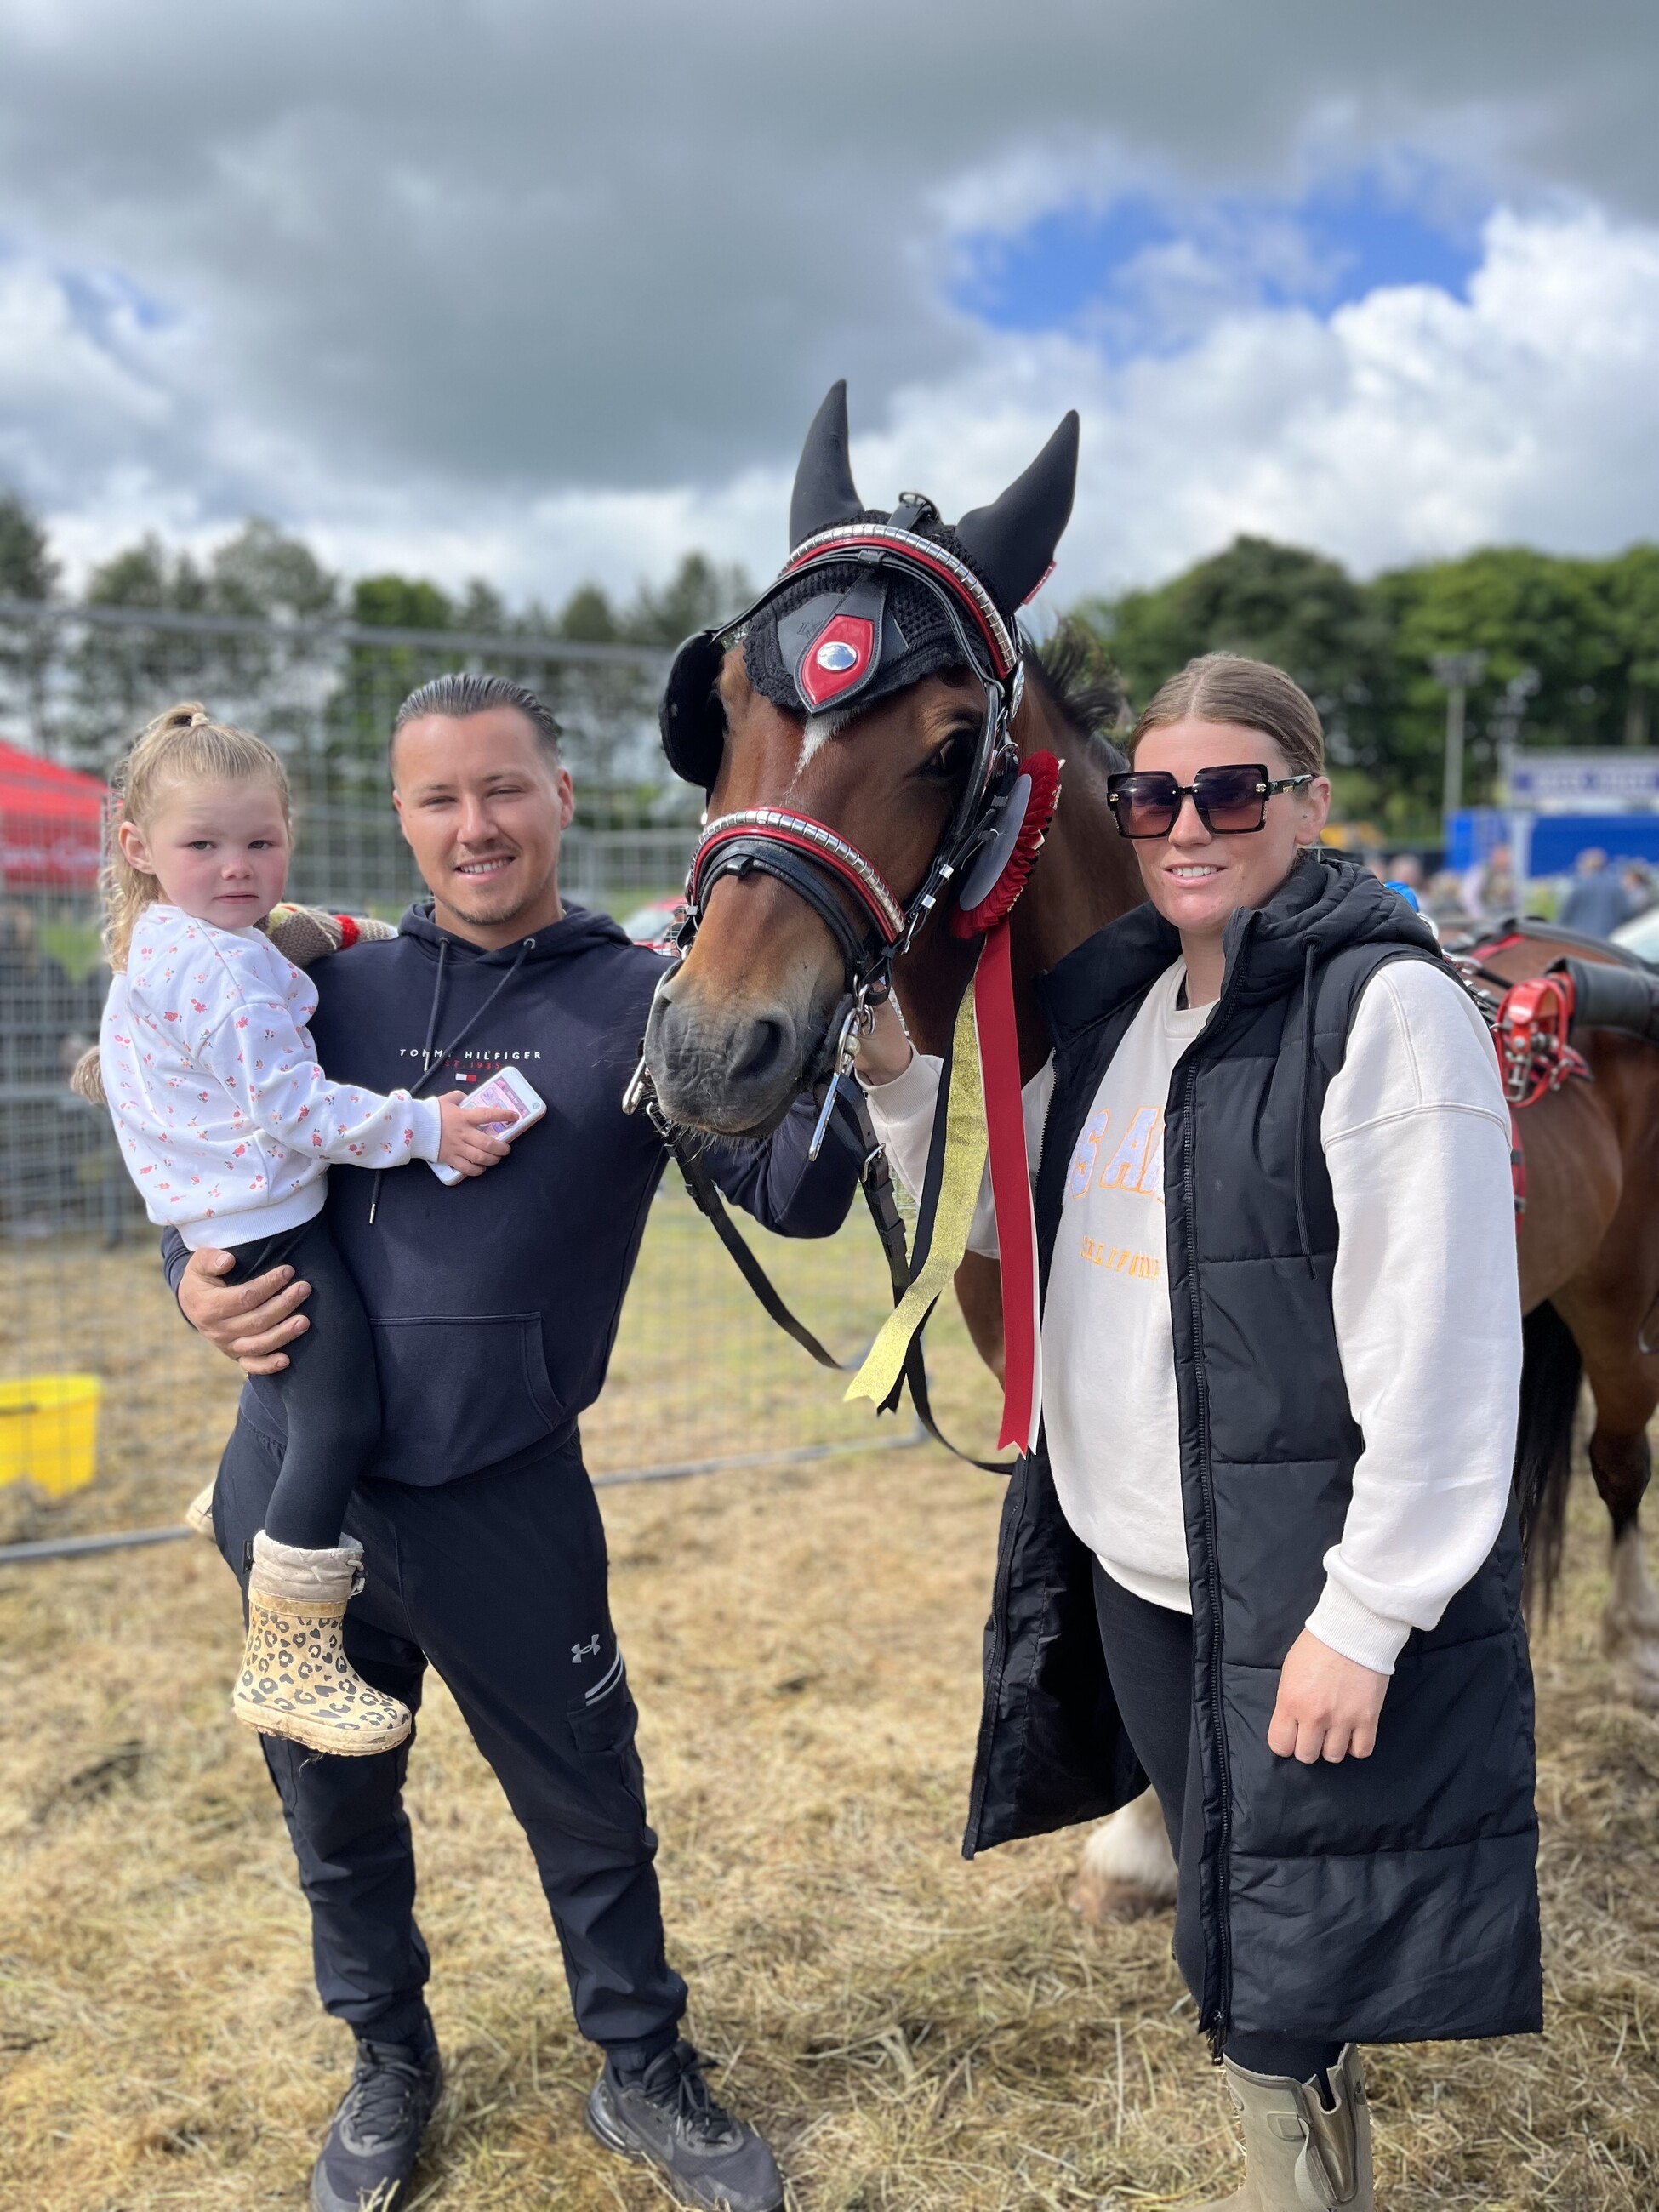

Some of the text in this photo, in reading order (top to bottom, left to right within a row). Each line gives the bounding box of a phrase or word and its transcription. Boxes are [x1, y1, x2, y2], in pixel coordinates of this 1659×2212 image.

[399, 1048, 541, 1060] TOMM HILFIGER
[470, 1061, 500, 1069] 1985
